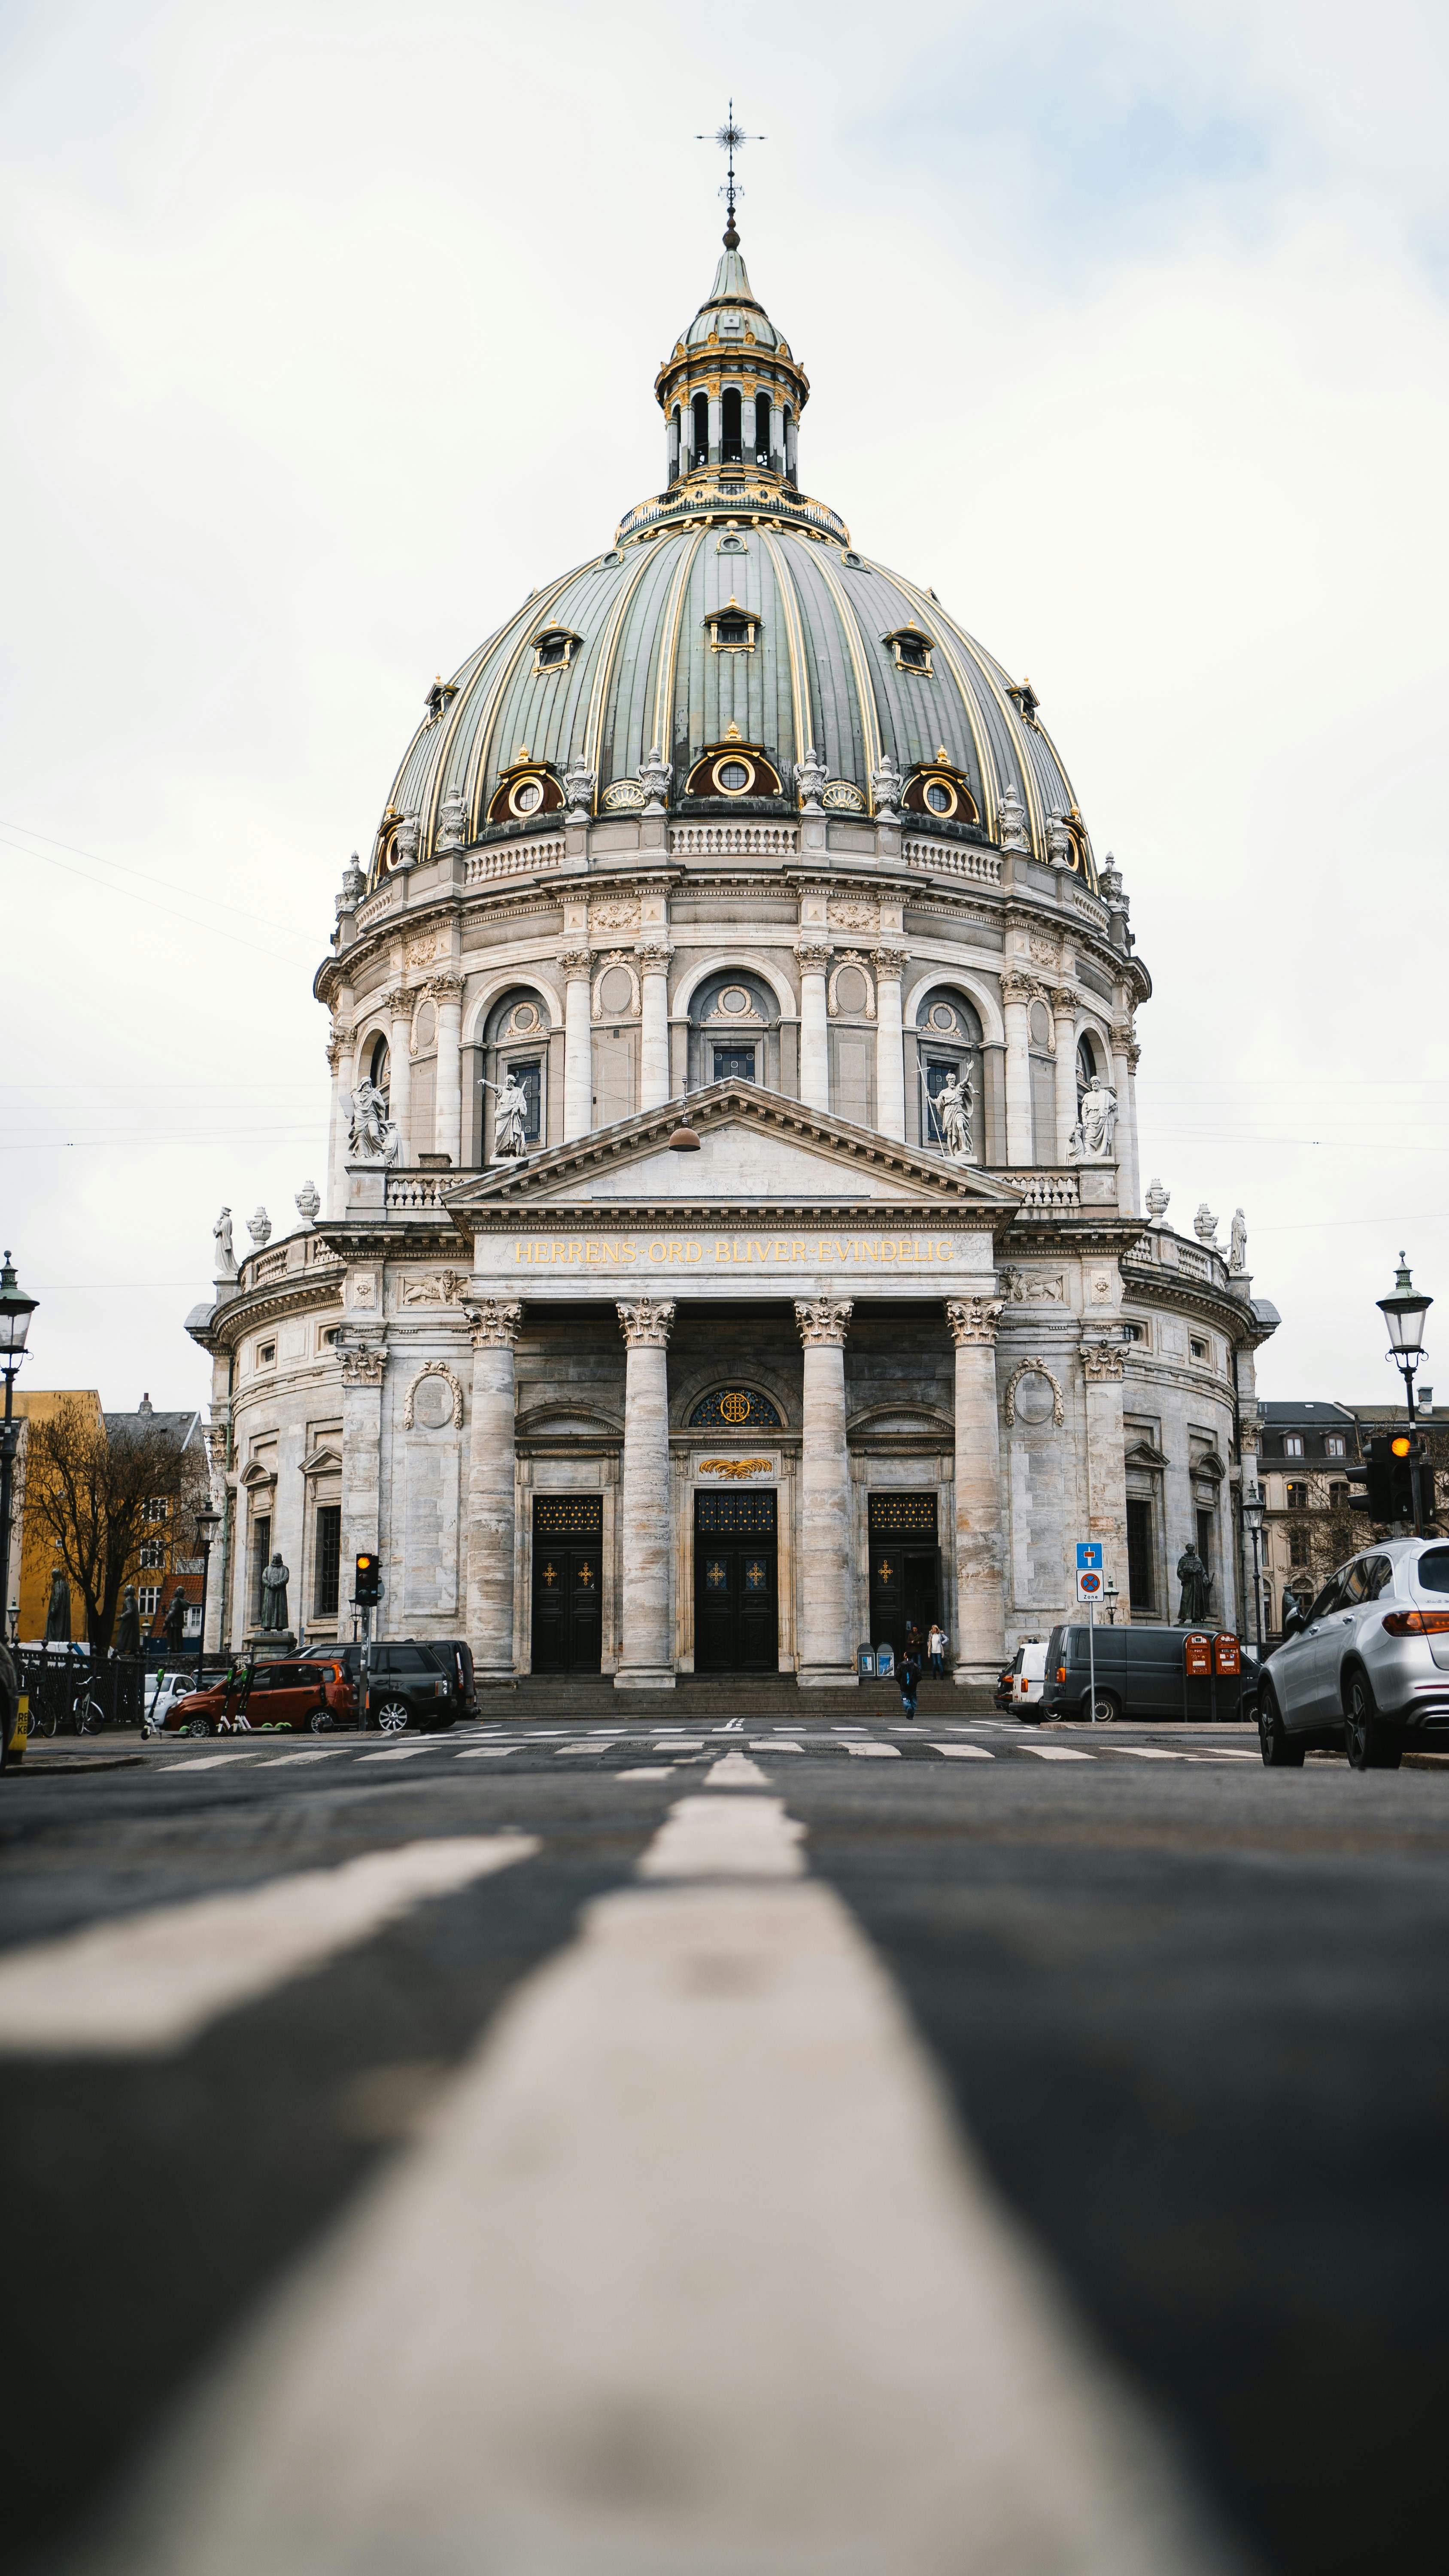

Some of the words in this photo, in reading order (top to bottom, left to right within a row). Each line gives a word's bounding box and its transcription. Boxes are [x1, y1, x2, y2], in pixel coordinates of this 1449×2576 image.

[515, 1242, 636, 1263] HERRENS
[648, 1242, 702, 1262] ORD
[715, 1241, 808, 1262] BLIVER
[818, 1241, 954, 1261] EVINDELIG
